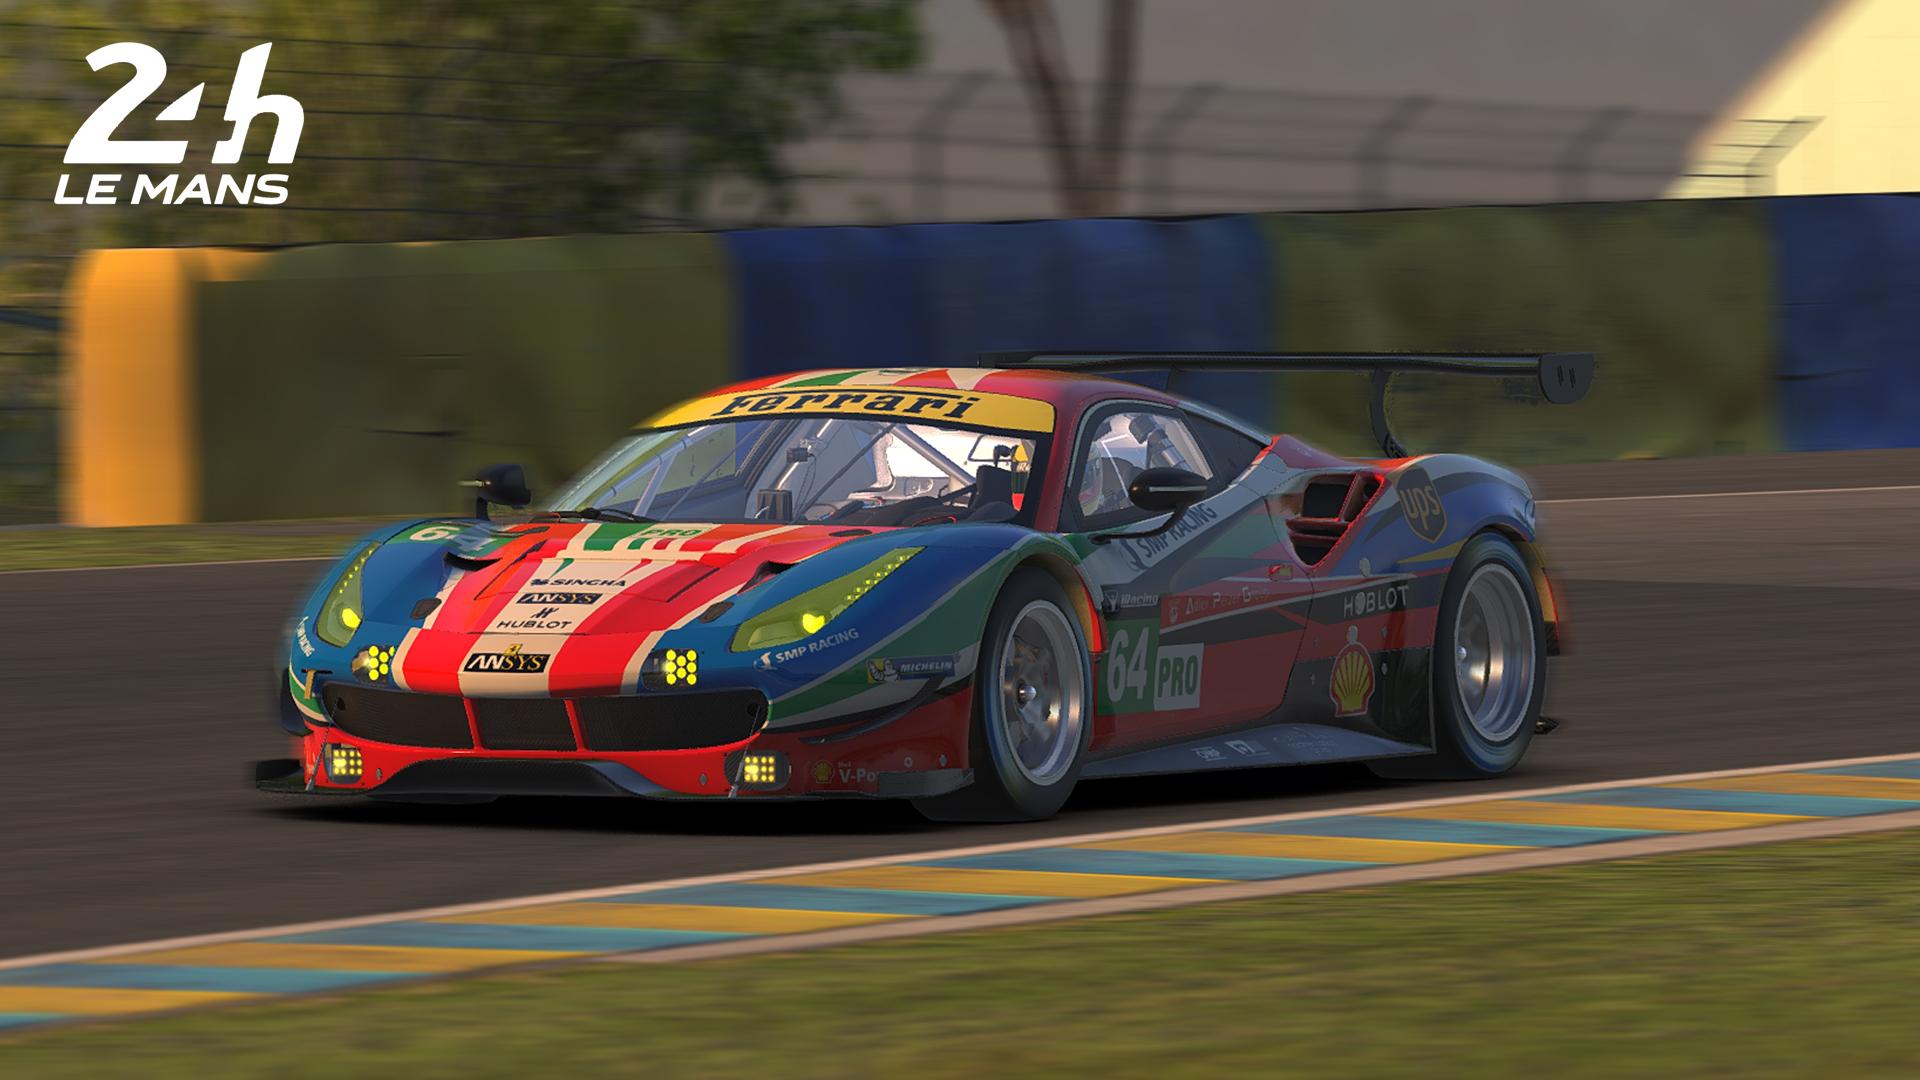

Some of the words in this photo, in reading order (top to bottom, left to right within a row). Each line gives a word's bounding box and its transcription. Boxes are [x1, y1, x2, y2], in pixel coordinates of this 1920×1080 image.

[710, 389, 980, 419] Ferrari
[1400, 485, 1441, 530] ups
[409, 526, 497, 551] 64
[640, 528, 704, 537] PRO
[1137, 533, 1168, 558] SMP
[1171, 503, 1218, 542] RACING
[550, 578, 627, 587] SINGHA
[519, 592, 600, 604] ANSYS
[1343, 585, 1409, 617] HBLOT
[496, 620, 573, 630] HUBLOT
[775, 646, 807, 663] SMP
[808, 628, 860, 652] RACING
[467, 655, 545, 671] ANSYS
[900, 661, 953, 673] MICHELIN
[1107, 627, 1149, 702] 64
[1157, 655, 1199, 697] PRO
